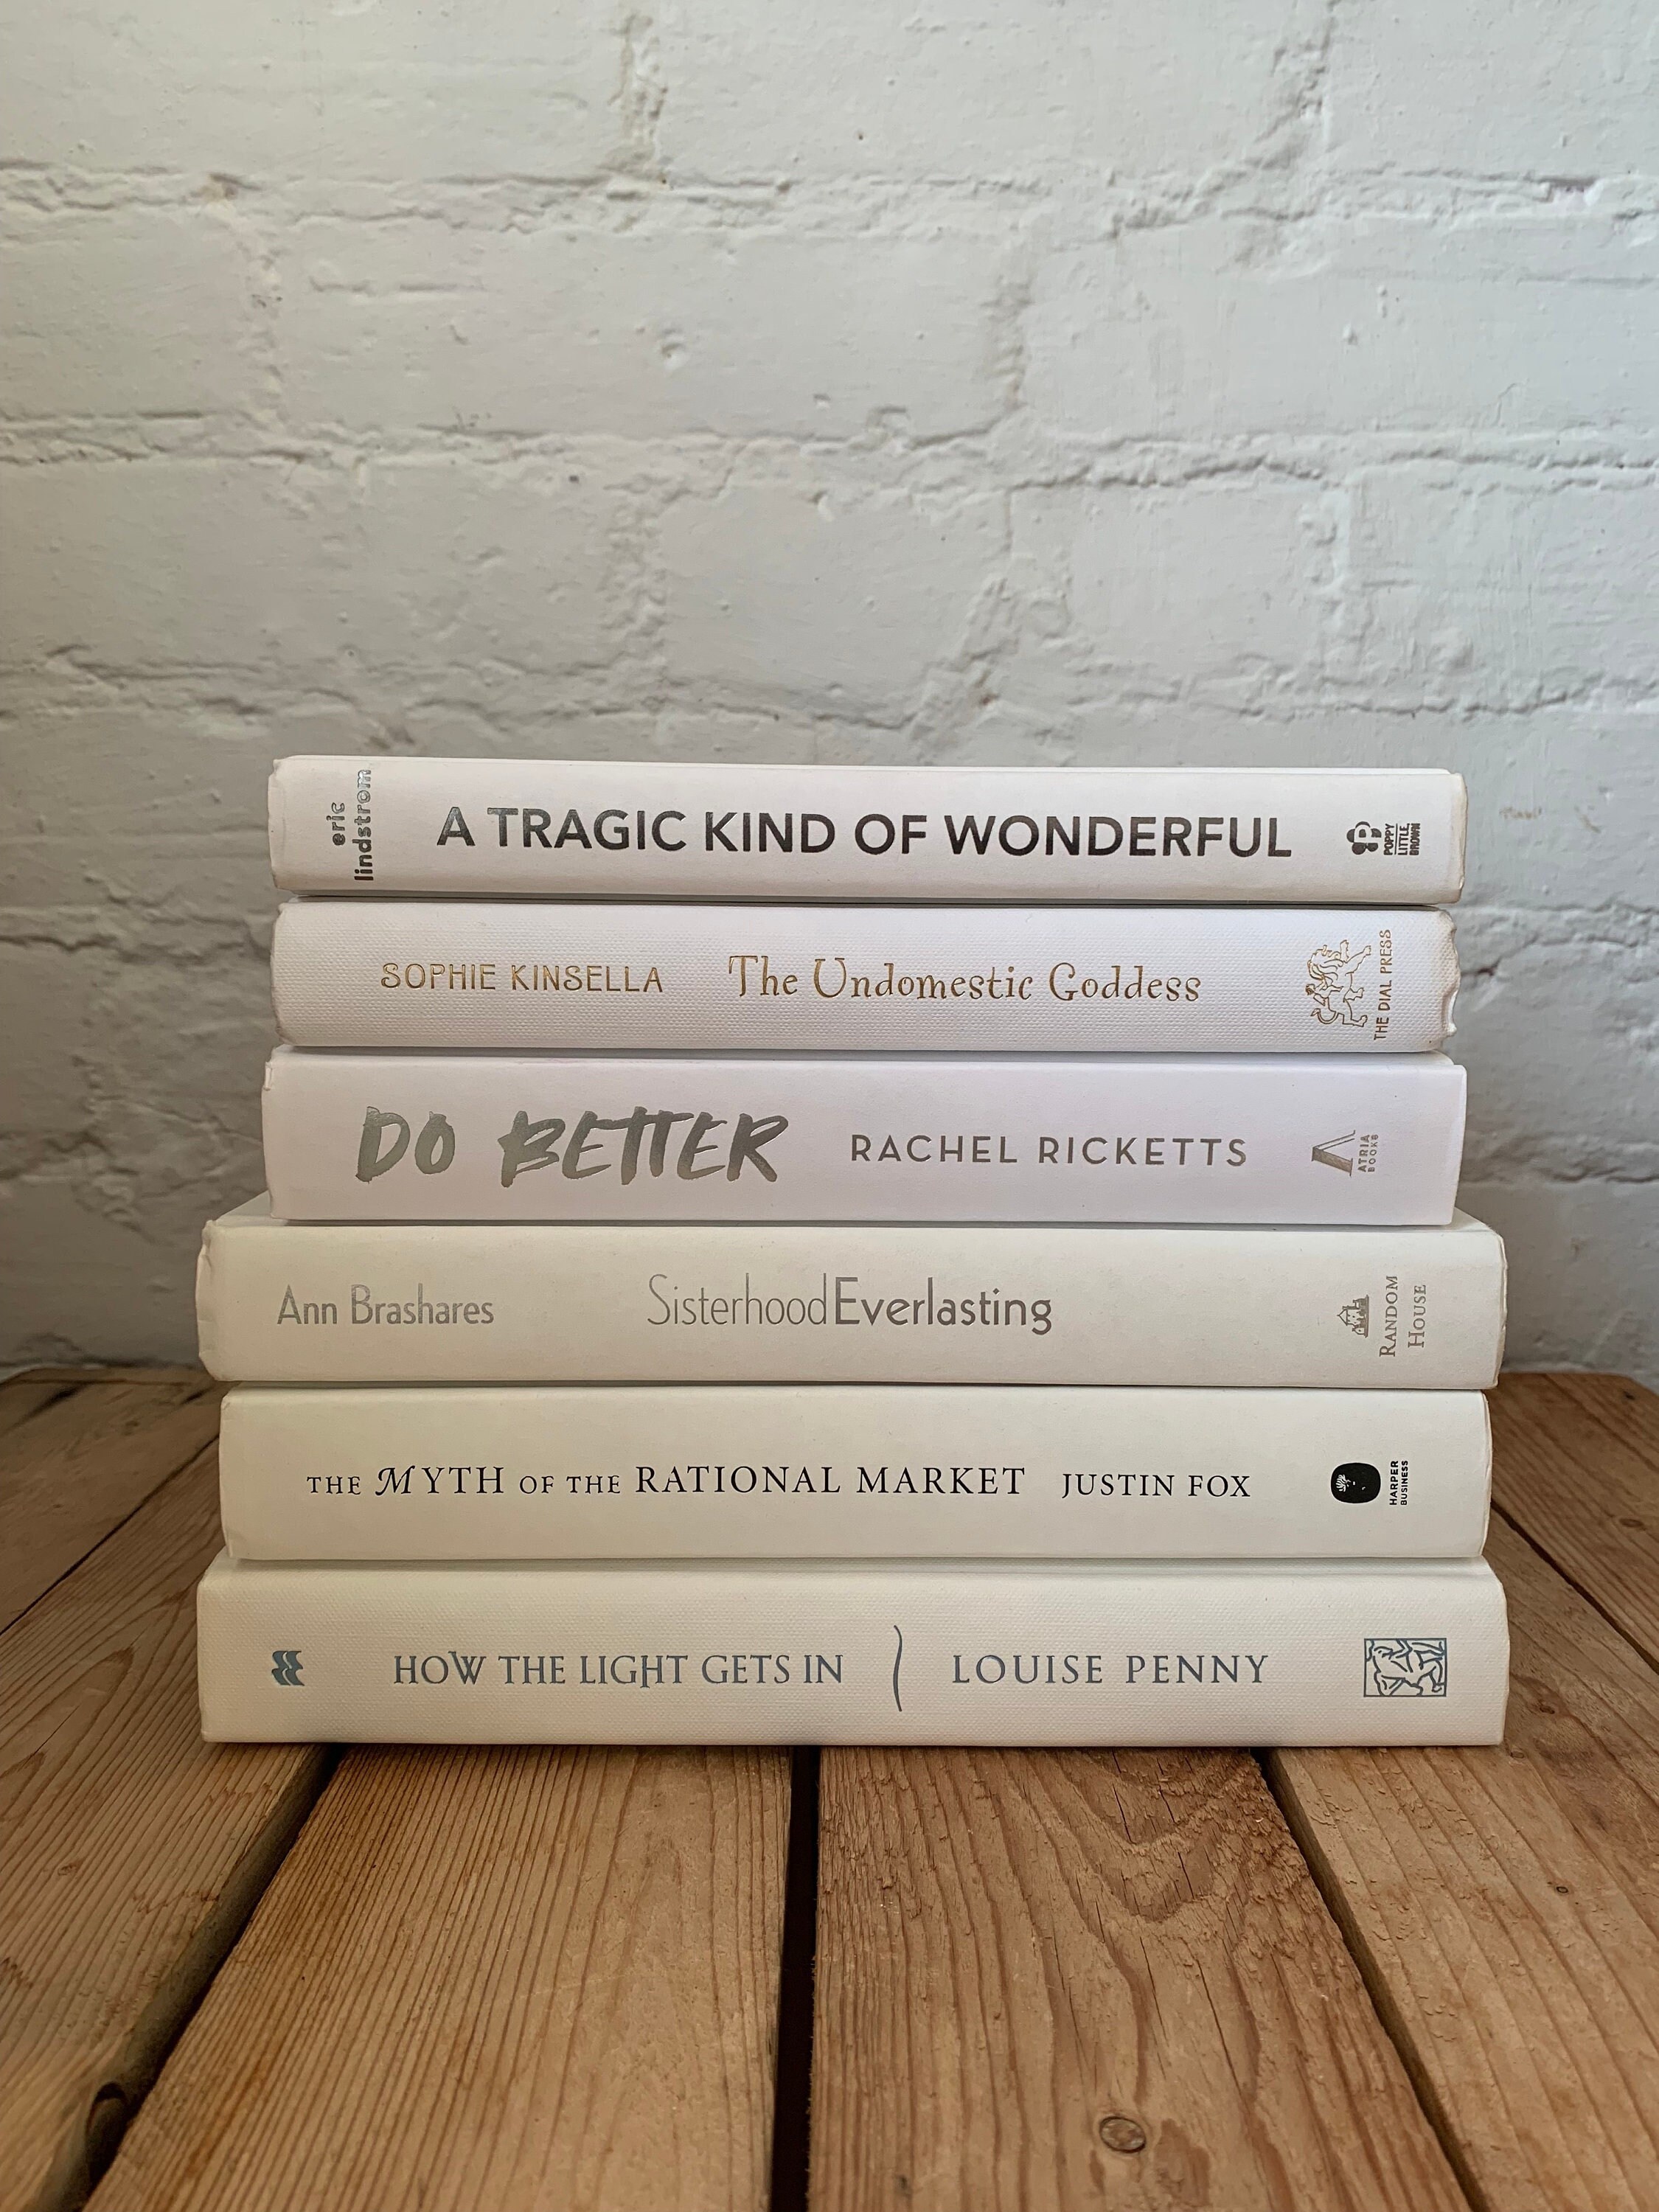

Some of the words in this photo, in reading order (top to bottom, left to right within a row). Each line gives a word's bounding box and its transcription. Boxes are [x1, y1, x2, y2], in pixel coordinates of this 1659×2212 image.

[326, 802, 345, 846] eric
[352, 769, 374, 881] lindstrom
[437, 807, 474, 846] A
[487, 807, 686, 852] TRAGIC
[705, 811, 836, 853] KIND
[855, 813, 928, 855] OF
[944, 815, 1292, 858] WONDERFUL
[1383, 823, 1395, 855] POPPY
[1409, 823, 1421, 856] BROWN
[1380, 929, 1393, 974] PRESS
[380, 962, 496, 992] SOPHIE
[511, 964, 664, 993] KINSELLA
[728, 955, 799, 998] The
[813, 958, 1033, 1001] Undomestic
[1048, 962, 1202, 1001] Goddess
[1378, 980, 1392, 1011] DIAL
[1374, 1017, 1389, 1040] THE
[355, 1105, 456, 1184] DO
[498, 1106, 789, 1189] BETTER
[851, 1134, 1018, 1164] RACHEL
[1037, 1136, 1247, 1166] RICKETTS
[1357, 1134, 1370, 1172] ATRIA
[1368, 1134, 1379, 1172] BOOKS
[276, 1284, 338, 1326] Ann
[350, 1283, 495, 1326] Brashares
[1379, 1276, 1398, 1357] RANDOM
[1408, 1284, 1427, 1348] HOUSE
[306, 1474, 361, 1496] THE
[374, 1464, 504, 1497] MYTH
[518, 1475, 554, 1496] OF
[566, 1475, 622, 1496] THE
[635, 1464, 841, 1495] RATIONAL
[855, 1466, 1026, 1495] MARKET
[1061, 1473, 1175, 1499] JUSTIN
[1187, 1475, 1251, 1498] FOX
[1389, 1461, 1399, 1506] HARPER
[1400, 1461, 1408, 1506] BUSINESS
[394, 1651, 487, 1686] HOW
[498, 1655, 567, 1686] THE
[579, 1654, 689, 1689] LIGHT
[700, 1654, 791, 1686] GETS
[804, 1654, 844, 1686] IN
[952, 1654, 1104, 1686] LOUISE
[1125, 1654, 1269, 1686] PENNY
